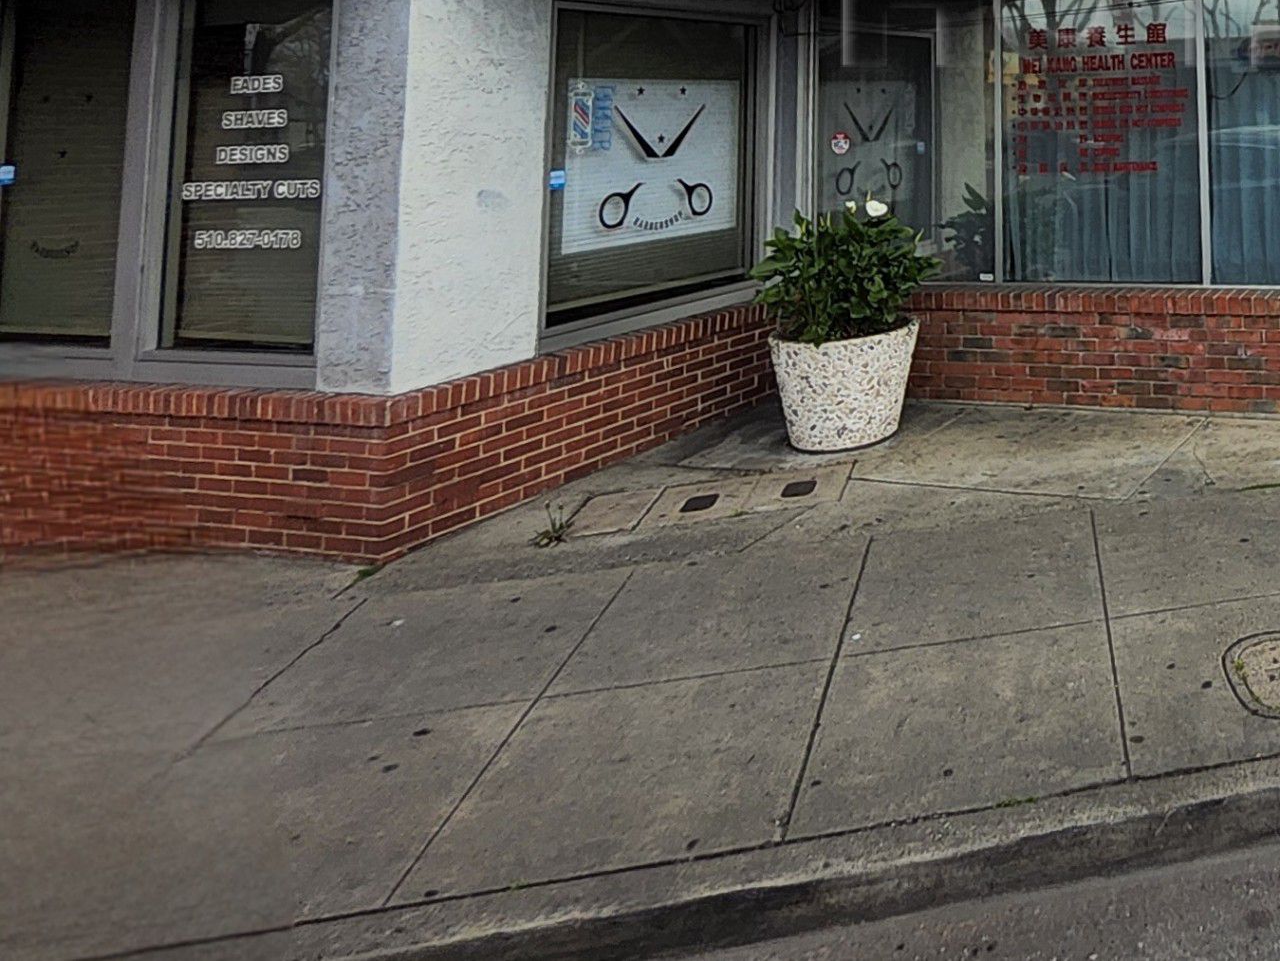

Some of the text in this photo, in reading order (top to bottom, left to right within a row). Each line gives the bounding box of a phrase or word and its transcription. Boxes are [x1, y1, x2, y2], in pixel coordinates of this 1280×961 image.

[1028, 22, 1168, 50] 美康養生館
[1021, 56, 1042, 74] MEI
[1082, 53, 1126, 72] HEALTH
[1130, 52, 1176, 69] CENTER
[222, 109, 287, 129] SHAVES
[216, 145, 289, 164] DESIGNS
[183, 180, 320, 200] SPECIALTY CUTS
